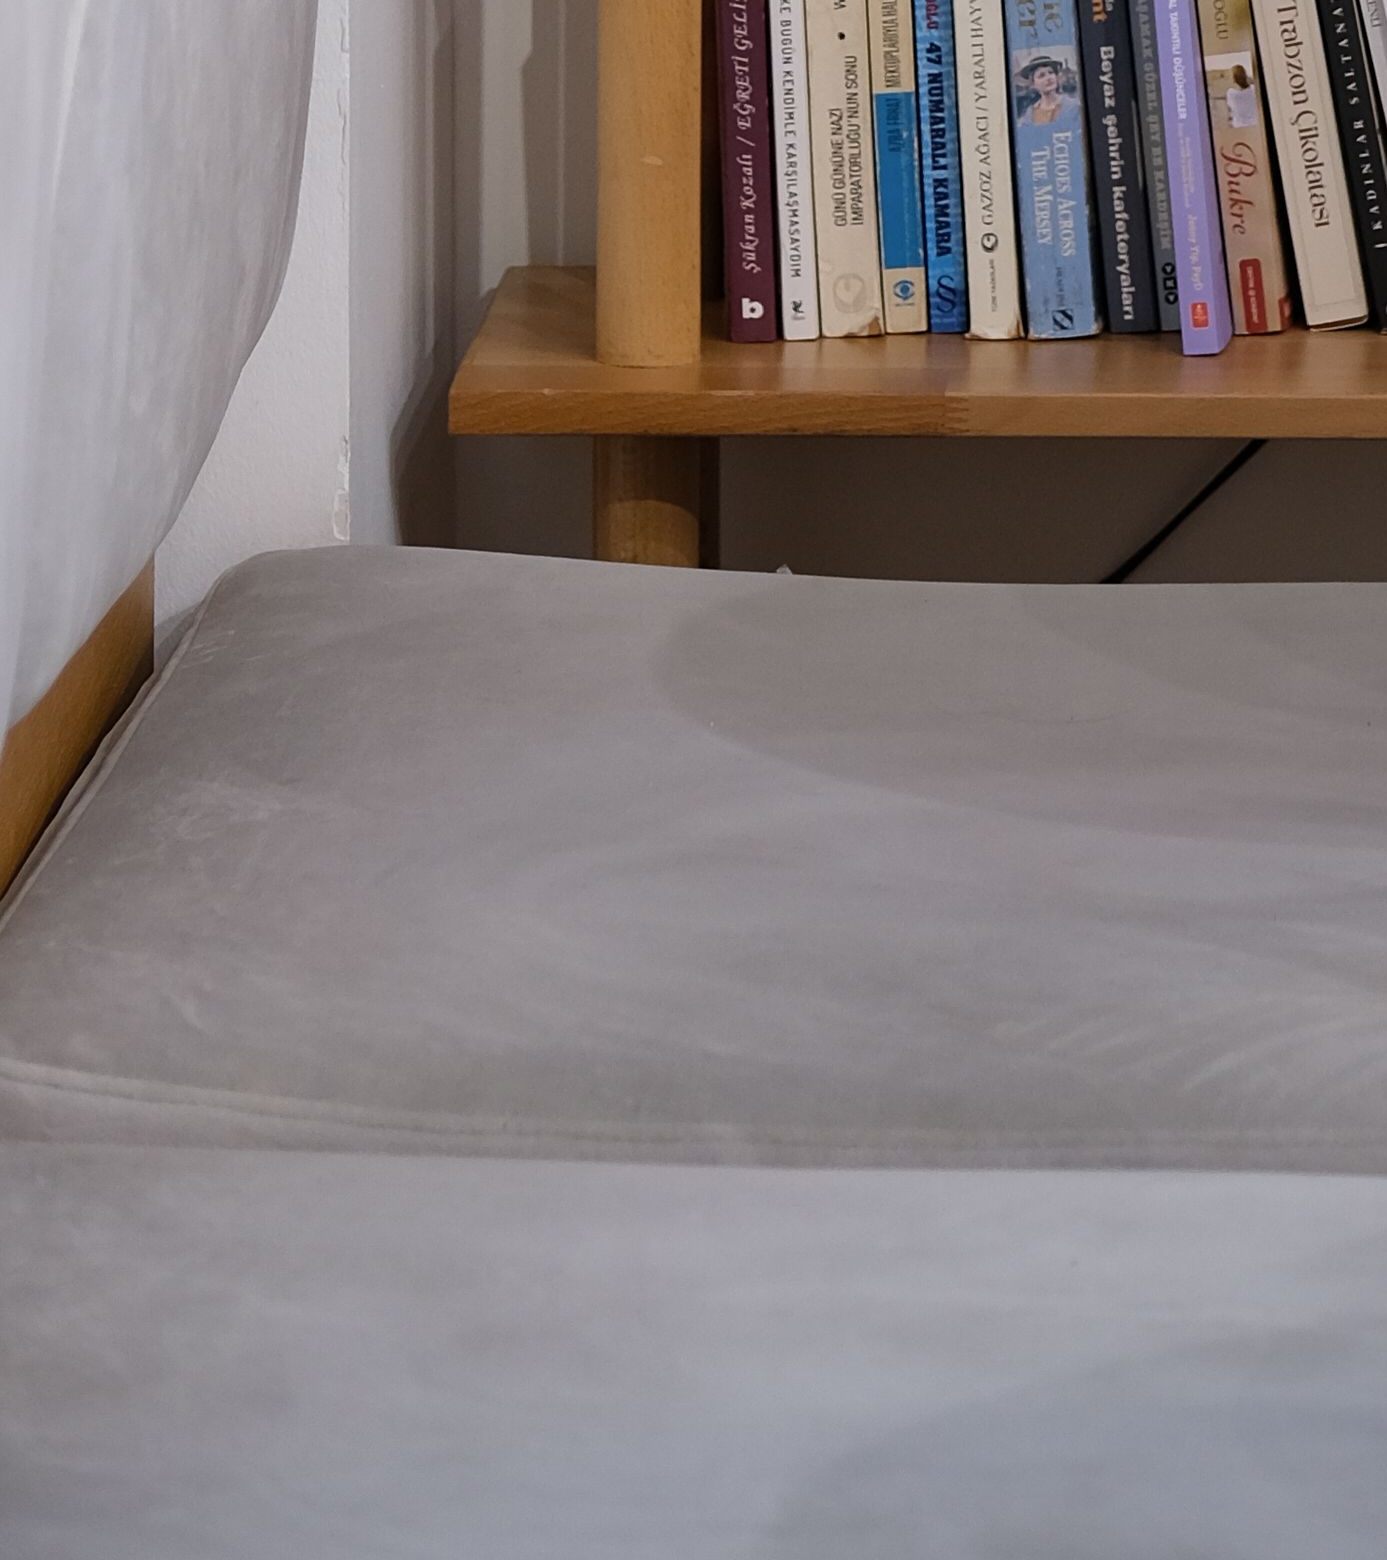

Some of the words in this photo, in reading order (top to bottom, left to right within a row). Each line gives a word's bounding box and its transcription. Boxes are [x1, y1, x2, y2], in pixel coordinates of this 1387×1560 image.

[926, 42, 943, 66] 47
[927, 71, 947, 171] NUMARALI
[1052, 129, 1072, 194] ECHOES
[1221, 141, 1257, 237] Bukre
[1290, 108, 1330, 228] Çikolatası
[1353, 119, 1384, 233] KADINLAR
[933, 175, 953, 258] KAMARA
[1056, 195, 1076, 257] ACROSS
